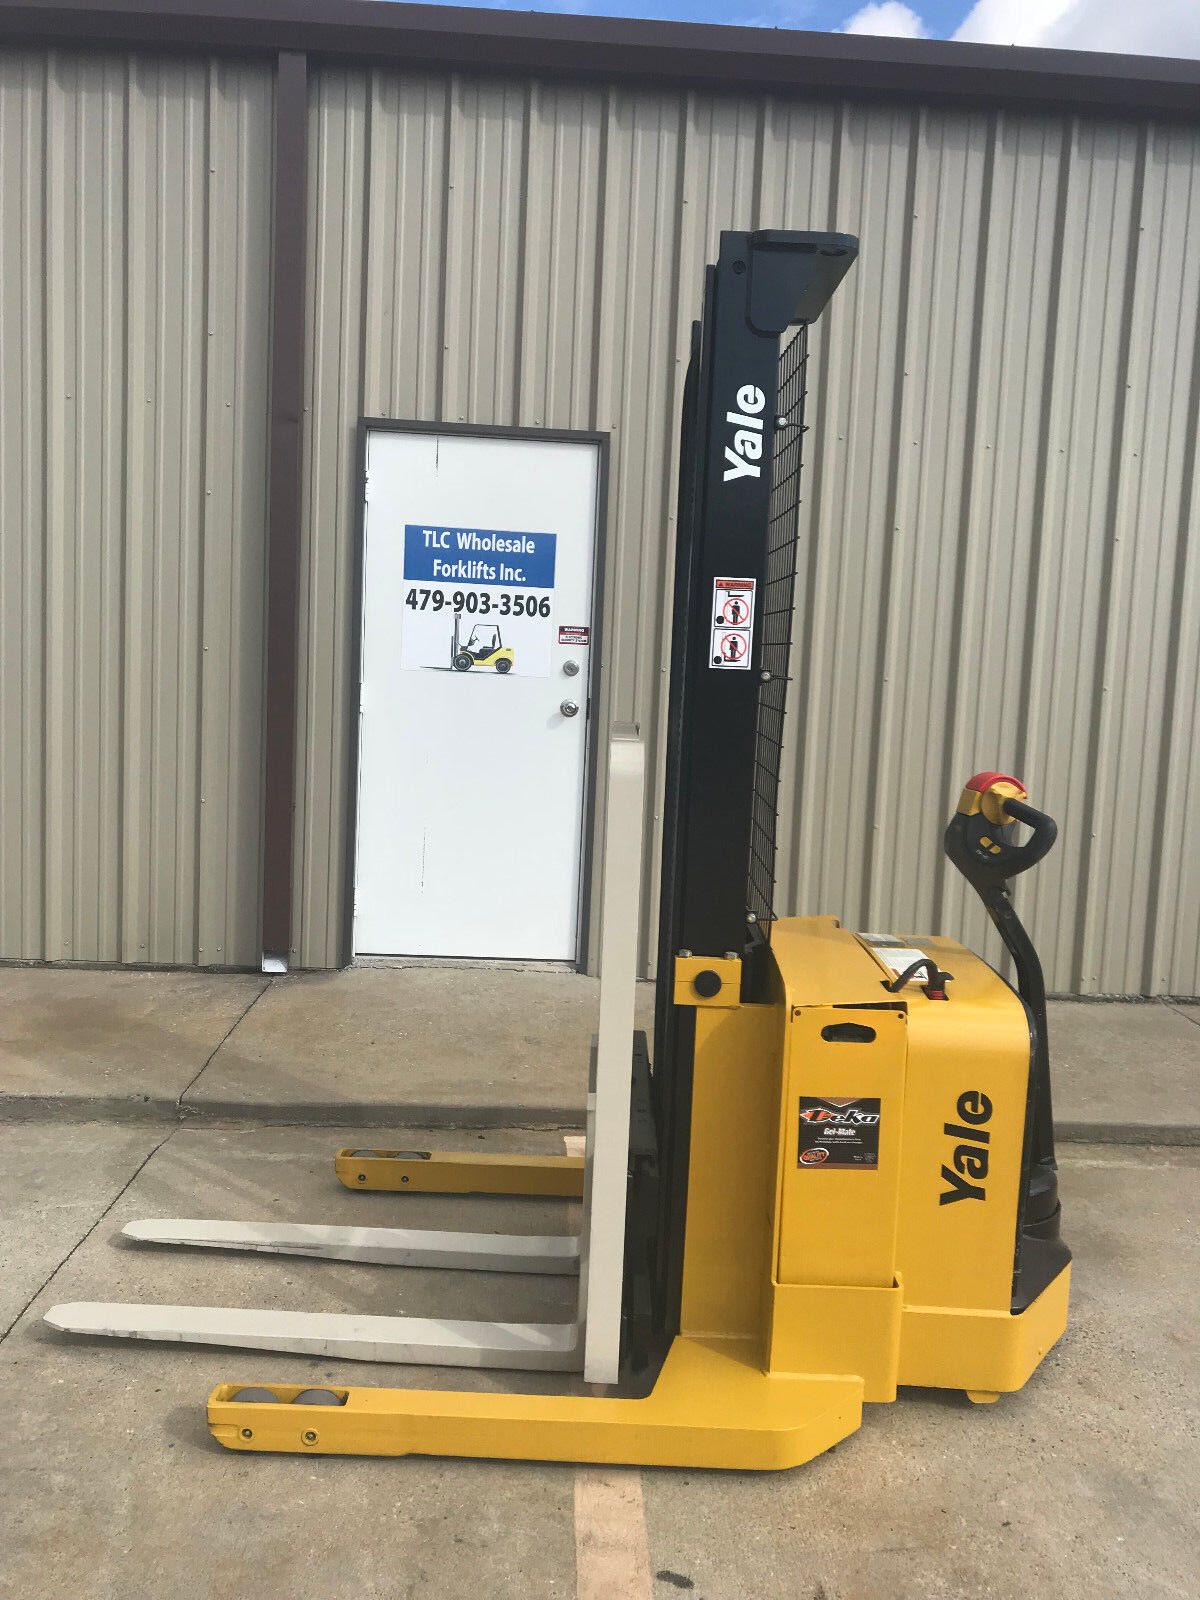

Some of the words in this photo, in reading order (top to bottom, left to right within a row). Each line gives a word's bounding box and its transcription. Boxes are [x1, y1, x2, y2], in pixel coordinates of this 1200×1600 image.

[723, 384, 765, 482] Yale
[423, 530, 450, 548] TLC
[457, 532, 535, 553] Wholesale
[433, 559, 496, 580] Forklifts
[500, 563, 526, 582] Inc.
[406, 588, 550, 617] 479-903-3506
[800, 1108, 880, 1125] Deka
[939, 1090, 993, 1206] Yale
